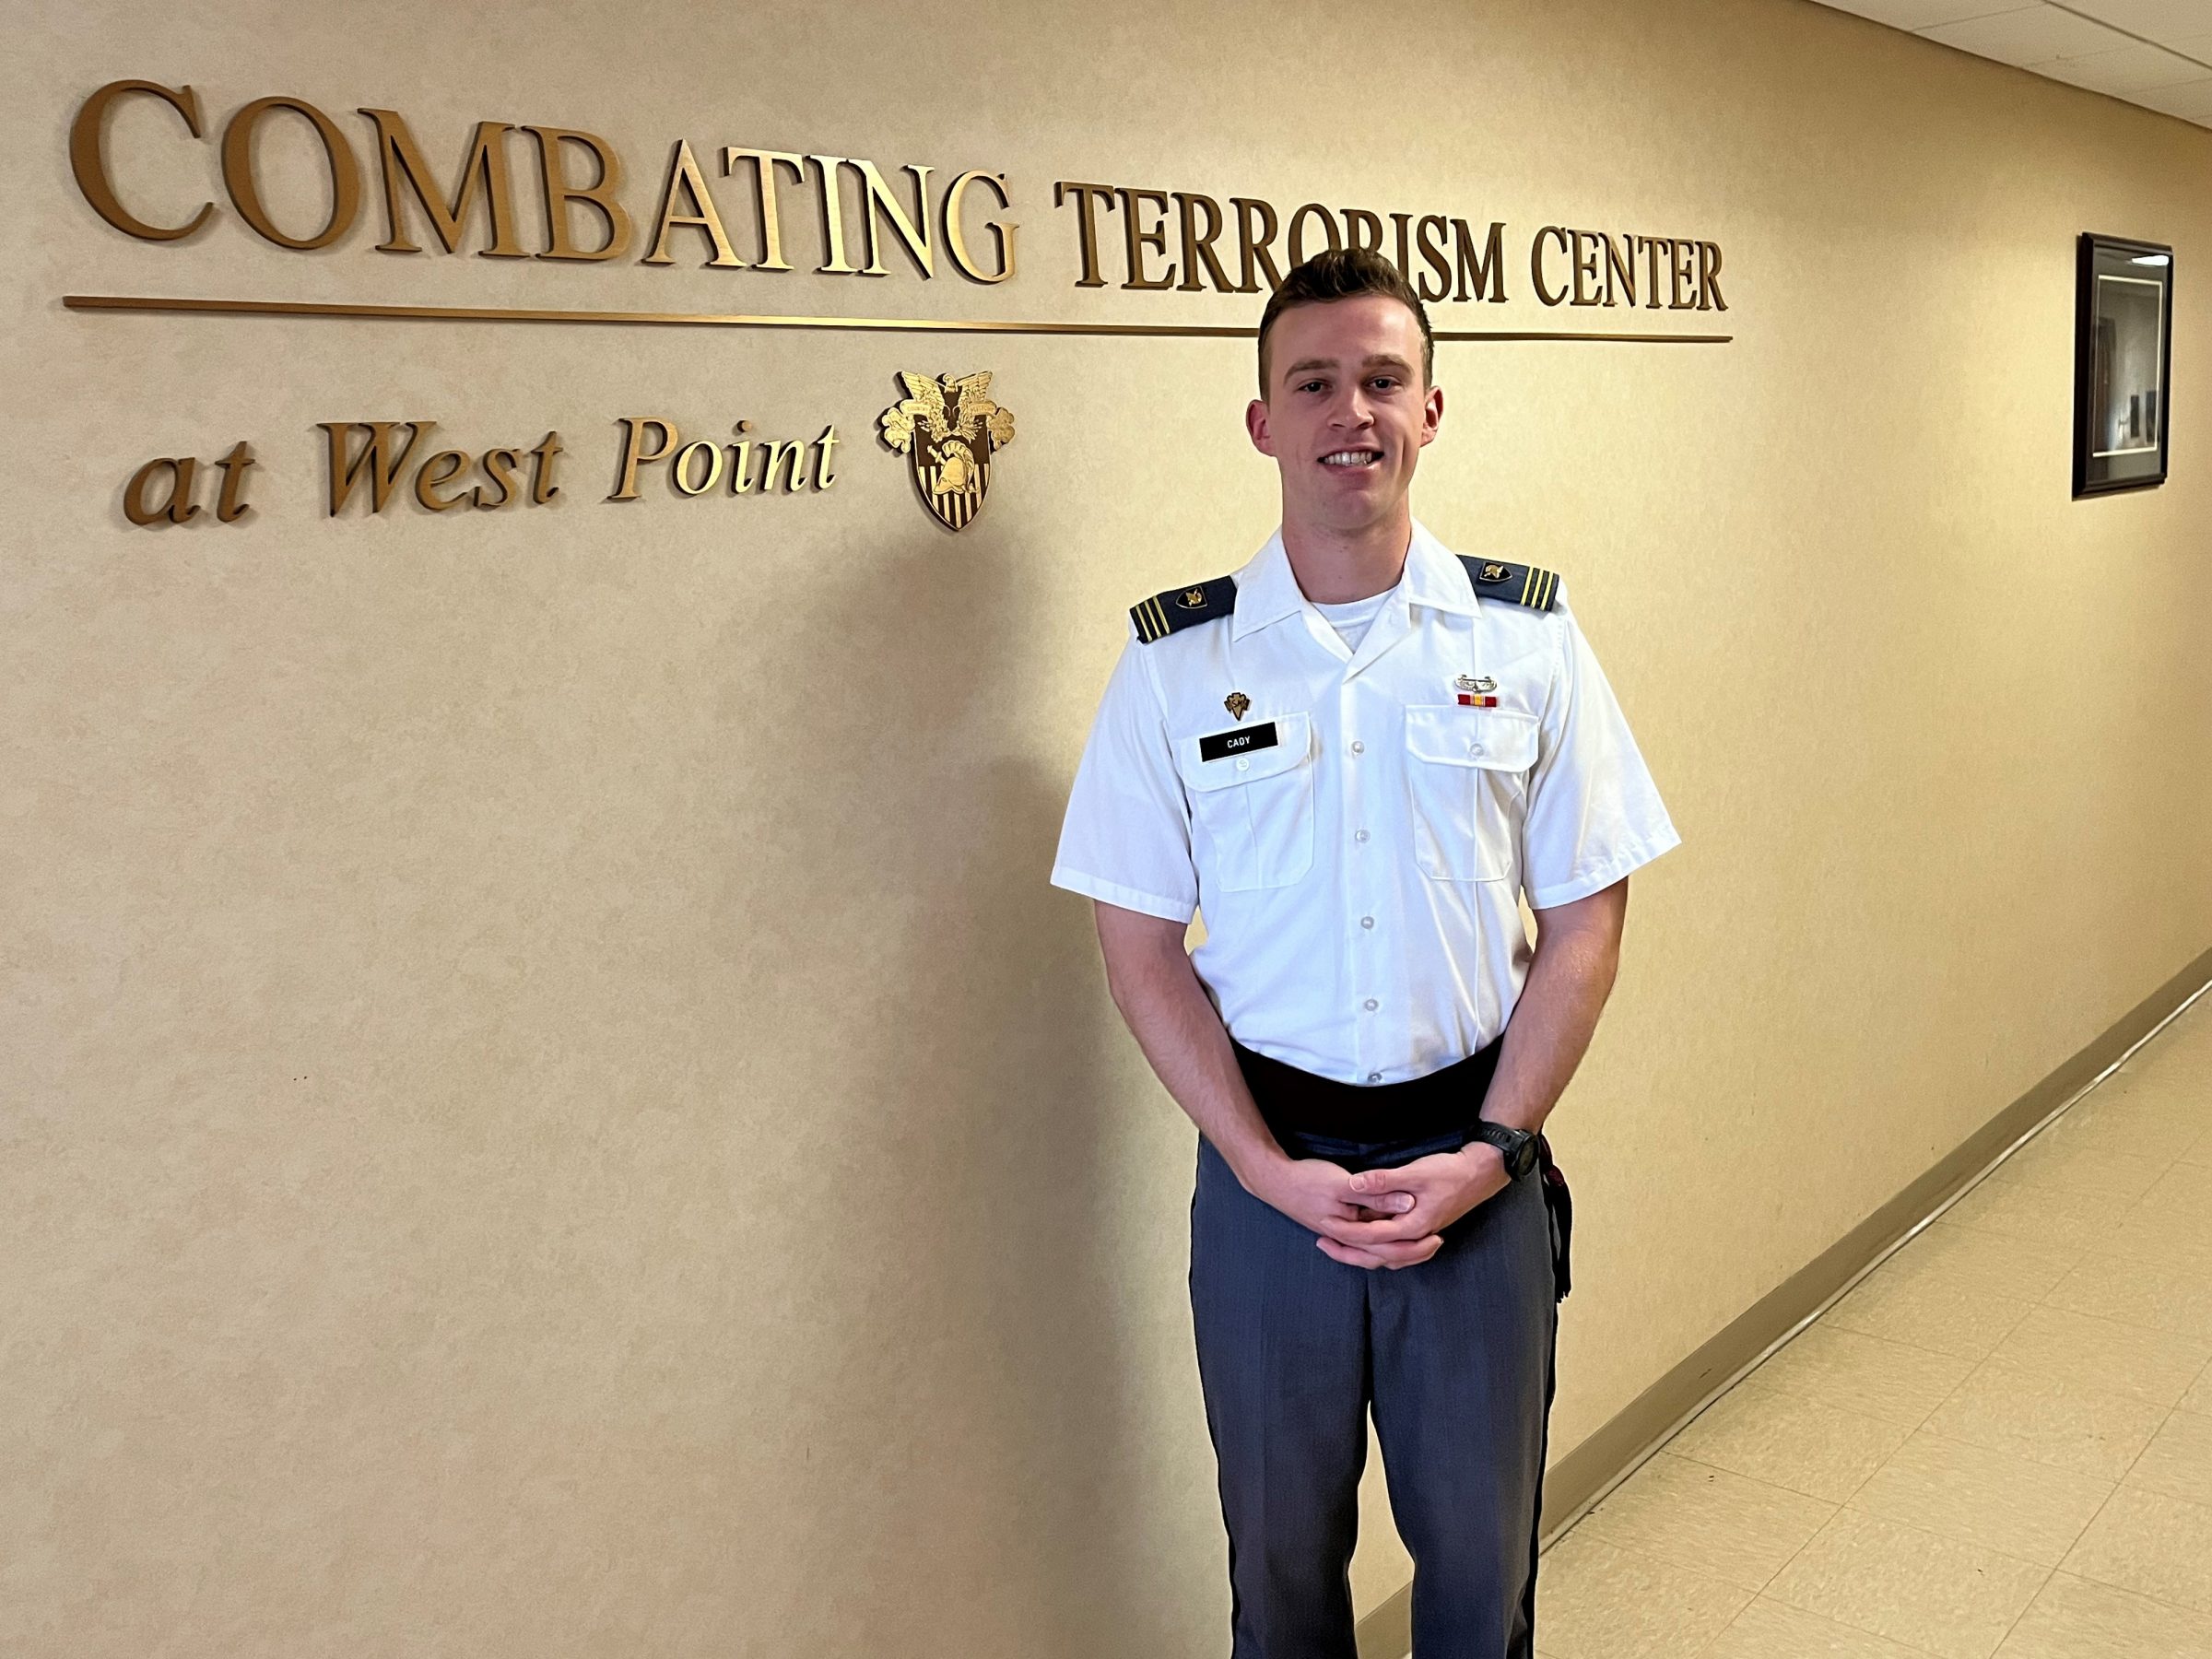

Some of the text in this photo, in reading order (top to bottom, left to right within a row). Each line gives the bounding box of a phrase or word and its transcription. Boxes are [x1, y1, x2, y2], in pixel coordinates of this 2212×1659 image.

[69, 79, 1020, 285] COMBATING
[1531, 225, 1729, 311] CENTER
[123, 441, 256, 524] at
[316, 420, 564, 518] West
[606, 417, 840, 502] Point
[1227, 735, 1251, 748] CADY
